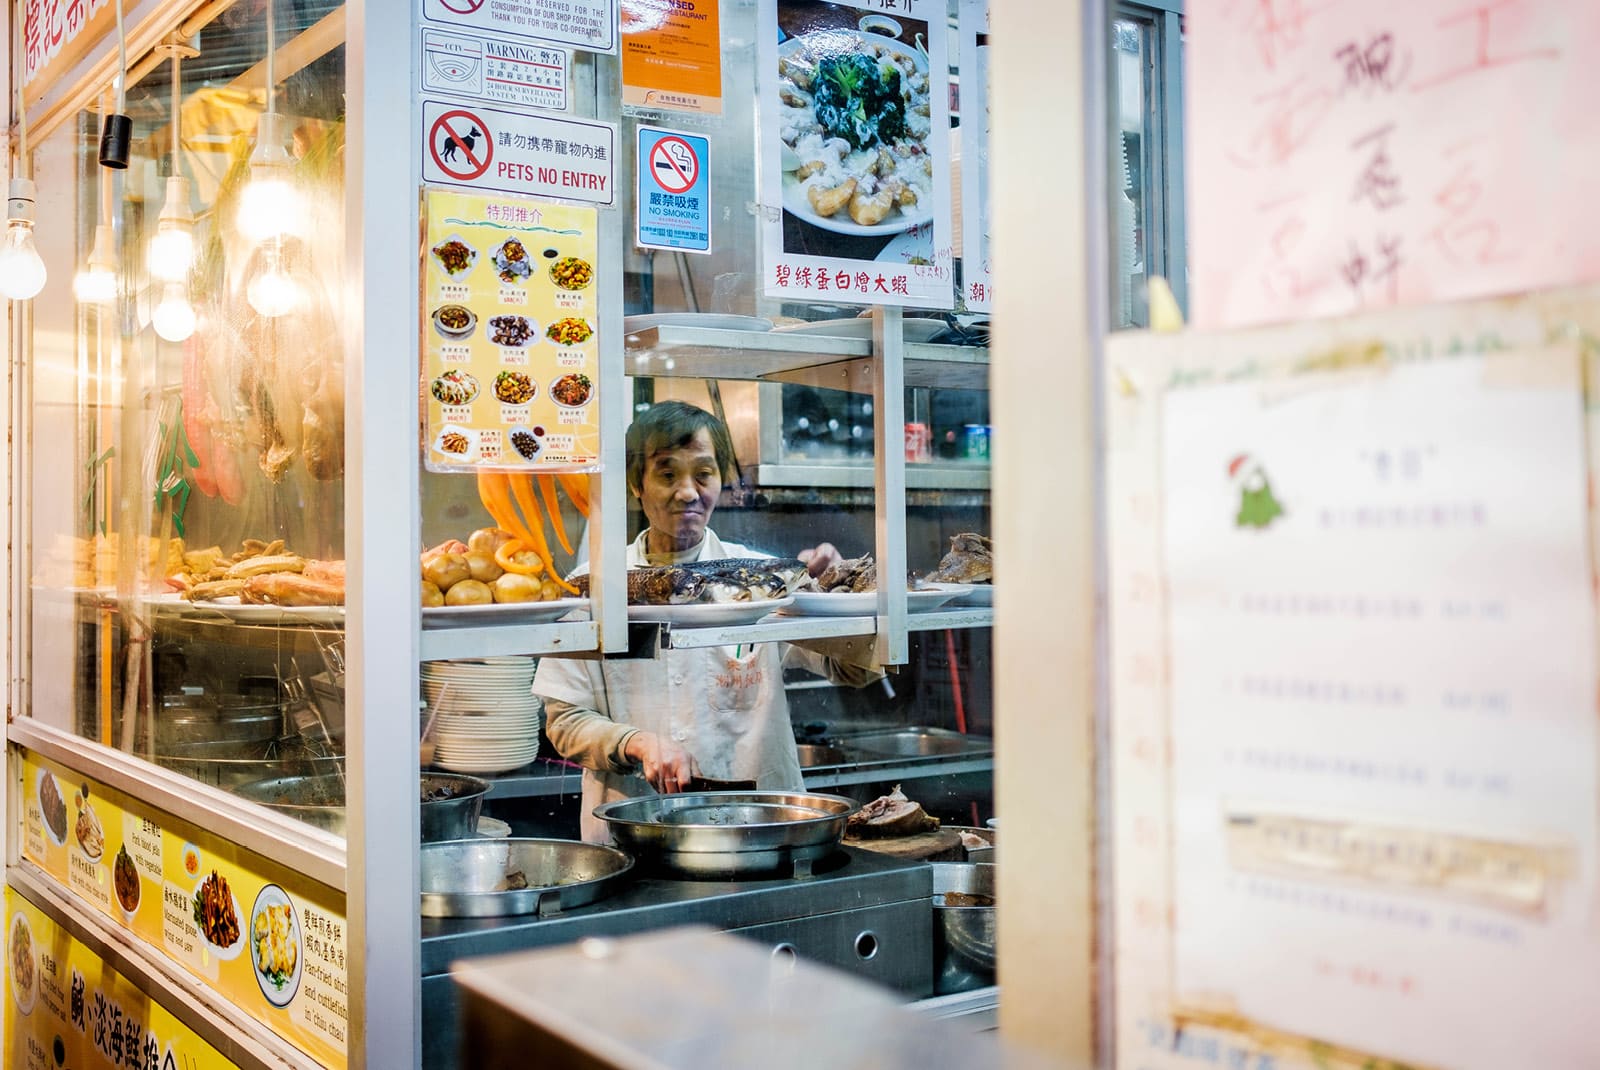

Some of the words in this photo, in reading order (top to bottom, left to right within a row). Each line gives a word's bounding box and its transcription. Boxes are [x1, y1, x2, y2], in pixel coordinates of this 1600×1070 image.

[490, 0, 533, 16] CONSUMPTION
[533, 8, 541, 17] OF
[542, 10, 555, 19] OUR
[556, 12, 572, 21] SHOP
[572, 15, 588, 25] FOOD
[588, 18, 603, 28] ONLY
[535, 0, 570, 12] RESERVED
[574, 5, 588, 15] FOR
[592, 9, 604, 18] THE
[491, 11, 511, 21] THANK
[513, 15, 526, 25] YOU
[527, 17, 540, 27] FOR
[541, 19, 559, 31] YOUR
[486, 42, 537, 62] WARNING:
[486, 90, 517, 100] SYSTEM
[521, 95, 562, 107] INSTALLED
[514, 87, 561, 99] SURVEILLANCE
[497, 161, 534, 182] PETS
[538, 167, 558, 185] NO
[562, 170, 607, 191] ENTRY
[649, 192, 699, 211] 嚴禁吸煙
[487, 203, 543, 224] 特別推介
[648, 206, 662, 216] NO
[662, 208, 700, 220] SMOKING
[304, 958, 332, 987] Pan-fried
[304, 985, 316, 1001] and
[304, 1005, 312, 1022] in
